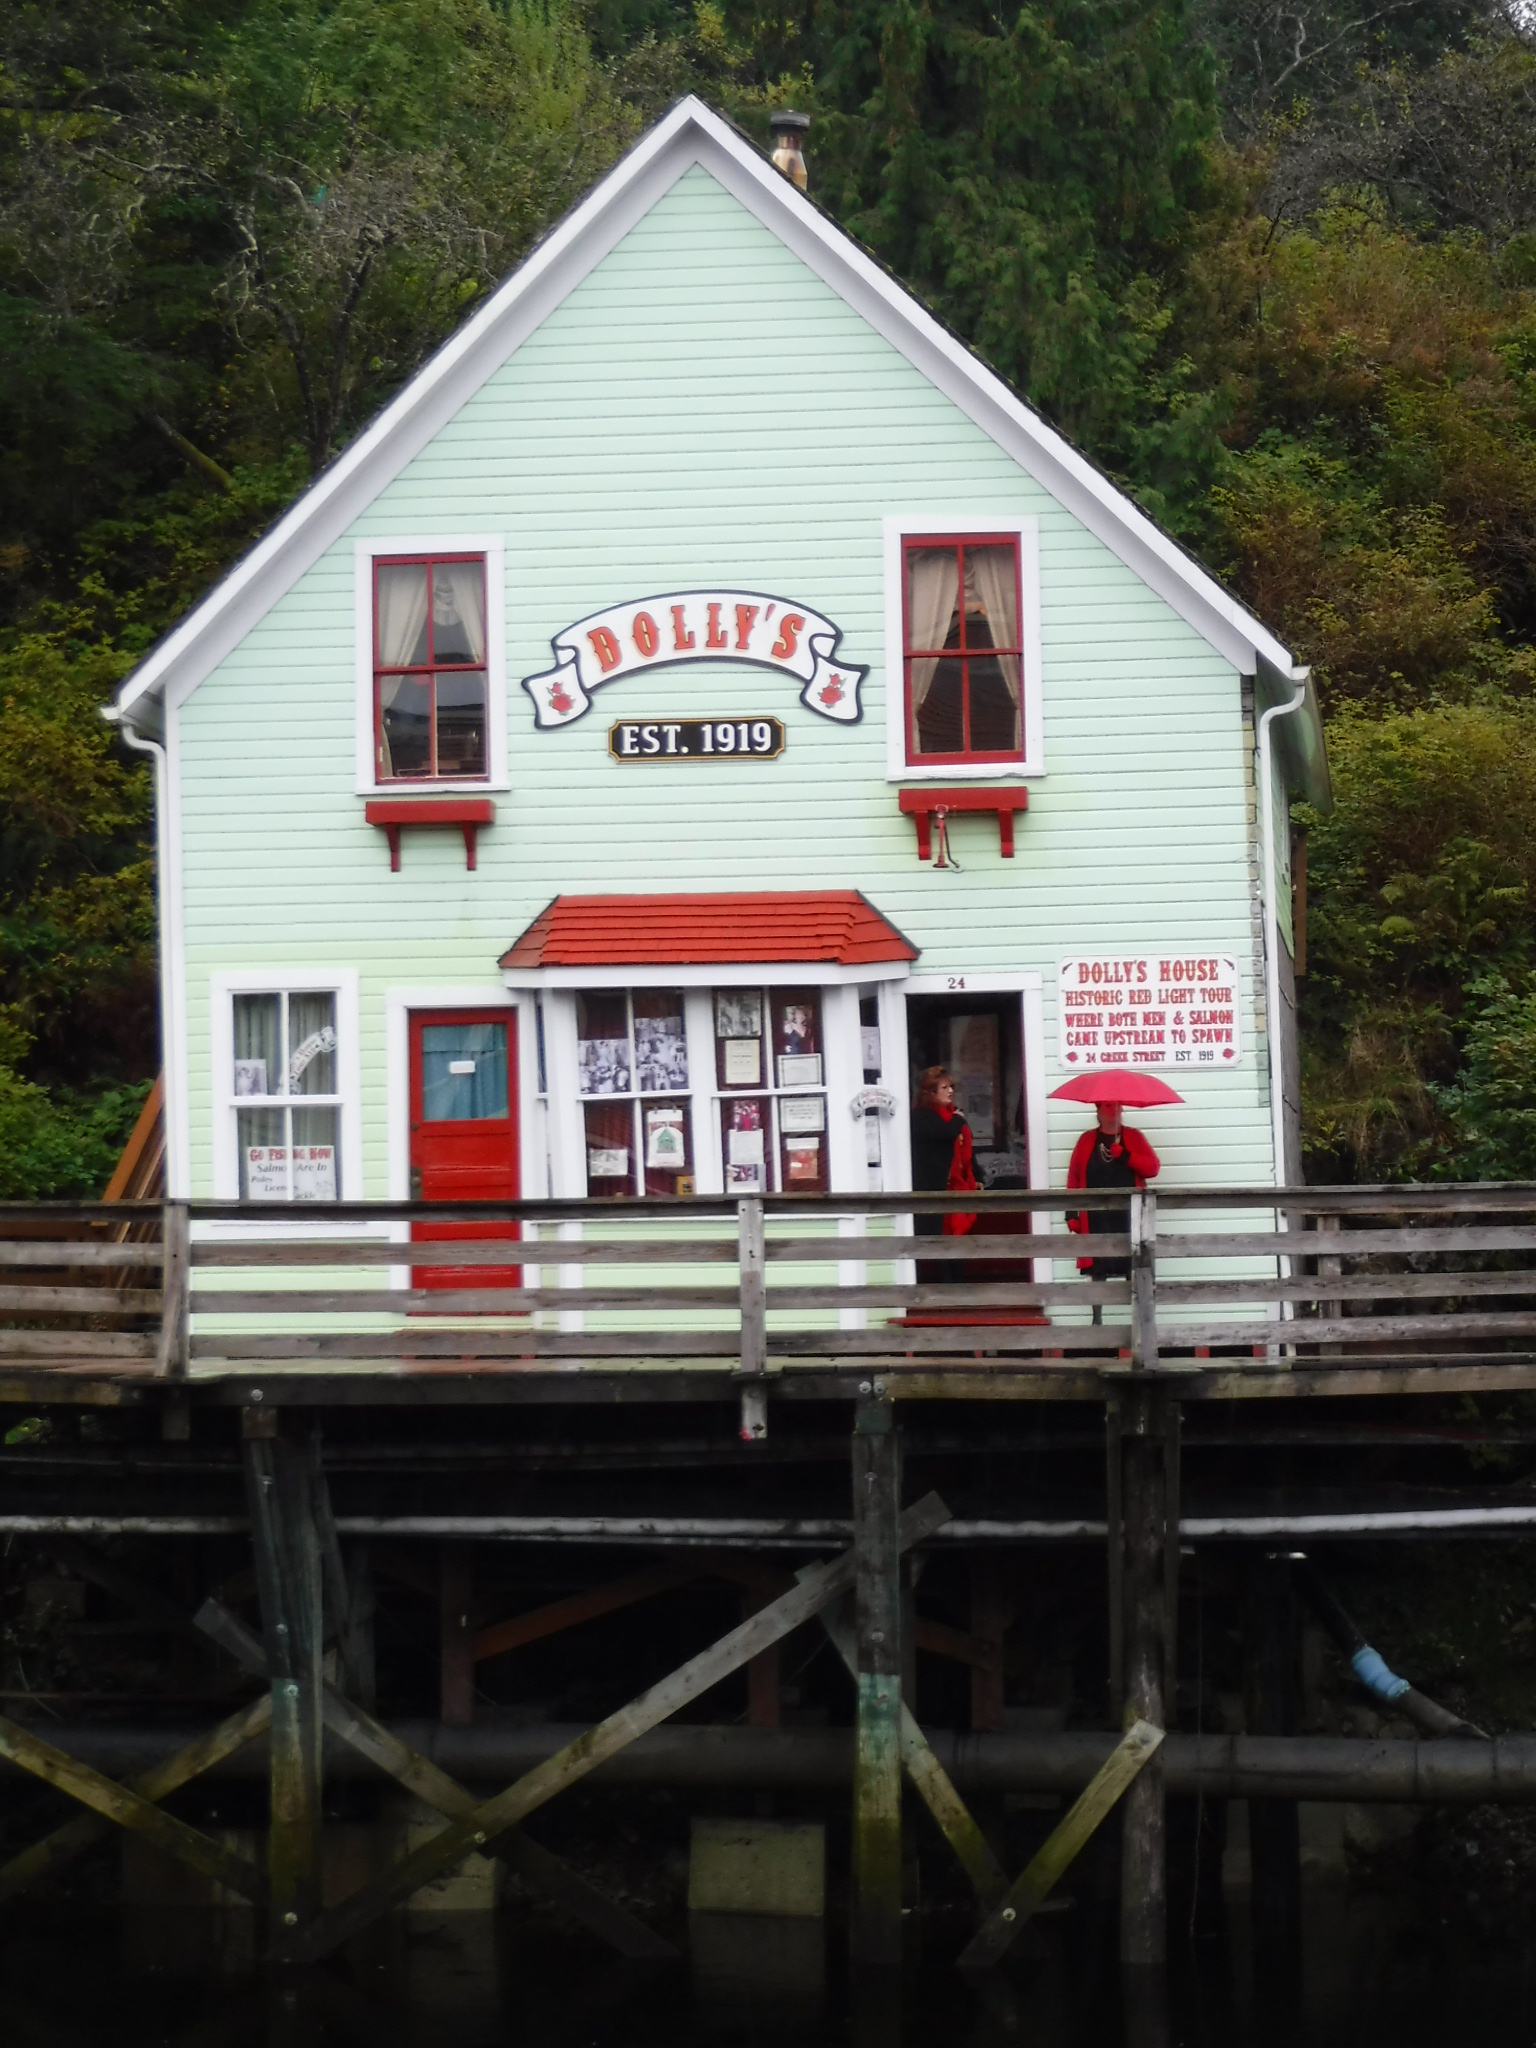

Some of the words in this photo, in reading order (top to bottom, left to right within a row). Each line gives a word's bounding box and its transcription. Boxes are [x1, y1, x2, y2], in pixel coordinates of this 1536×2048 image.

[586, 602, 807, 674] DOLLY'S
[622, 724, 689, 755] EST.
[702, 721, 772, 753] 1919
[1078, 959, 1148, 984] DOLLY'S
[1159, 958, 1219, 982] HOUSE
[947, 976, 966, 989] 24
[1128, 989, 1152, 1004] RED
[1158, 988, 1195, 1004] LIGHT
[1064, 1012, 1104, 1028] WHERE
[1108, 1011, 1137, 1027] BOTH
[1143, 1010, 1166, 1026] MEN
[1173, 1010, 1184, 1025] &
[1189, 1009, 1234, 1025] SALMON
[1066, 1030, 1098, 1046] CAME
[1104, 1028, 1165, 1046] UPSTREAM
[1170, 1029, 1186, 1044] TO
[1192, 1028, 1233, 1044] SPAWN
[1086, 1052, 1096, 1063] 24
[1100, 1051, 1128, 1063] CREEK
[1132, 1050, 1166, 1062] STREET
[1198, 1050, 1214, 1061] 1919
[249, 1148, 264, 1162] GO
[309, 1147, 333, 1160] NOW
[256, 1163, 288, 1173] Salmo
